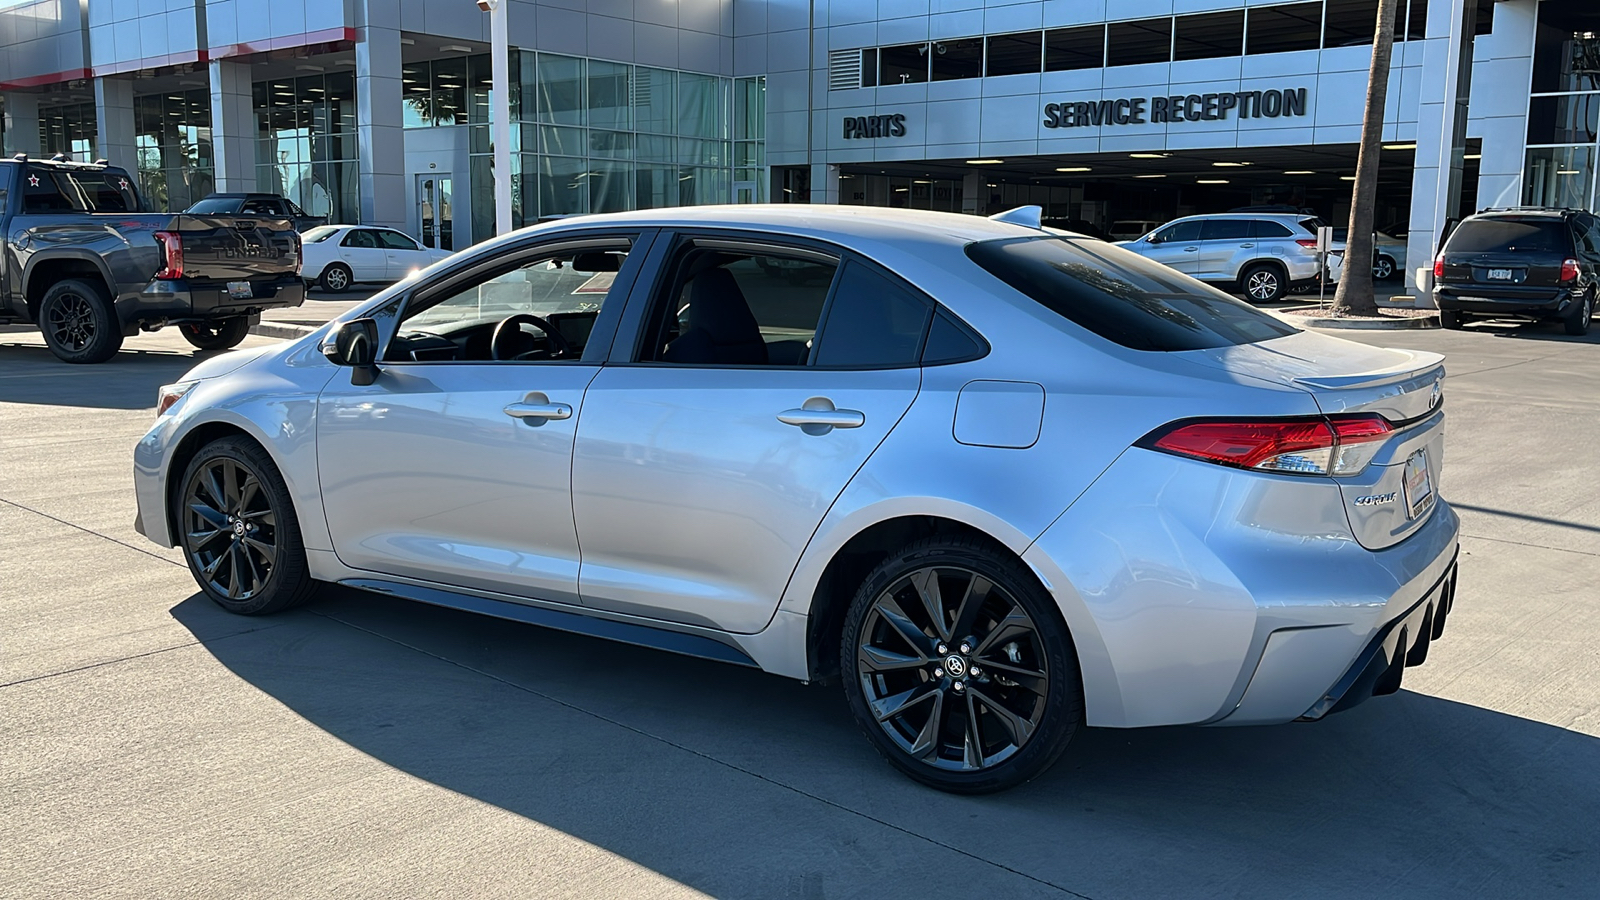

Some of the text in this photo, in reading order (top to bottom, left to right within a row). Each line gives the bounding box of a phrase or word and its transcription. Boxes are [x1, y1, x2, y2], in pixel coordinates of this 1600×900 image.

[1043, 87, 1307, 128] SERVICE RECEPTION
[843, 113, 906, 139] PARTS
[210, 246, 279, 260] TUNDRA
[1353, 491, 1398, 506] COROLLA
